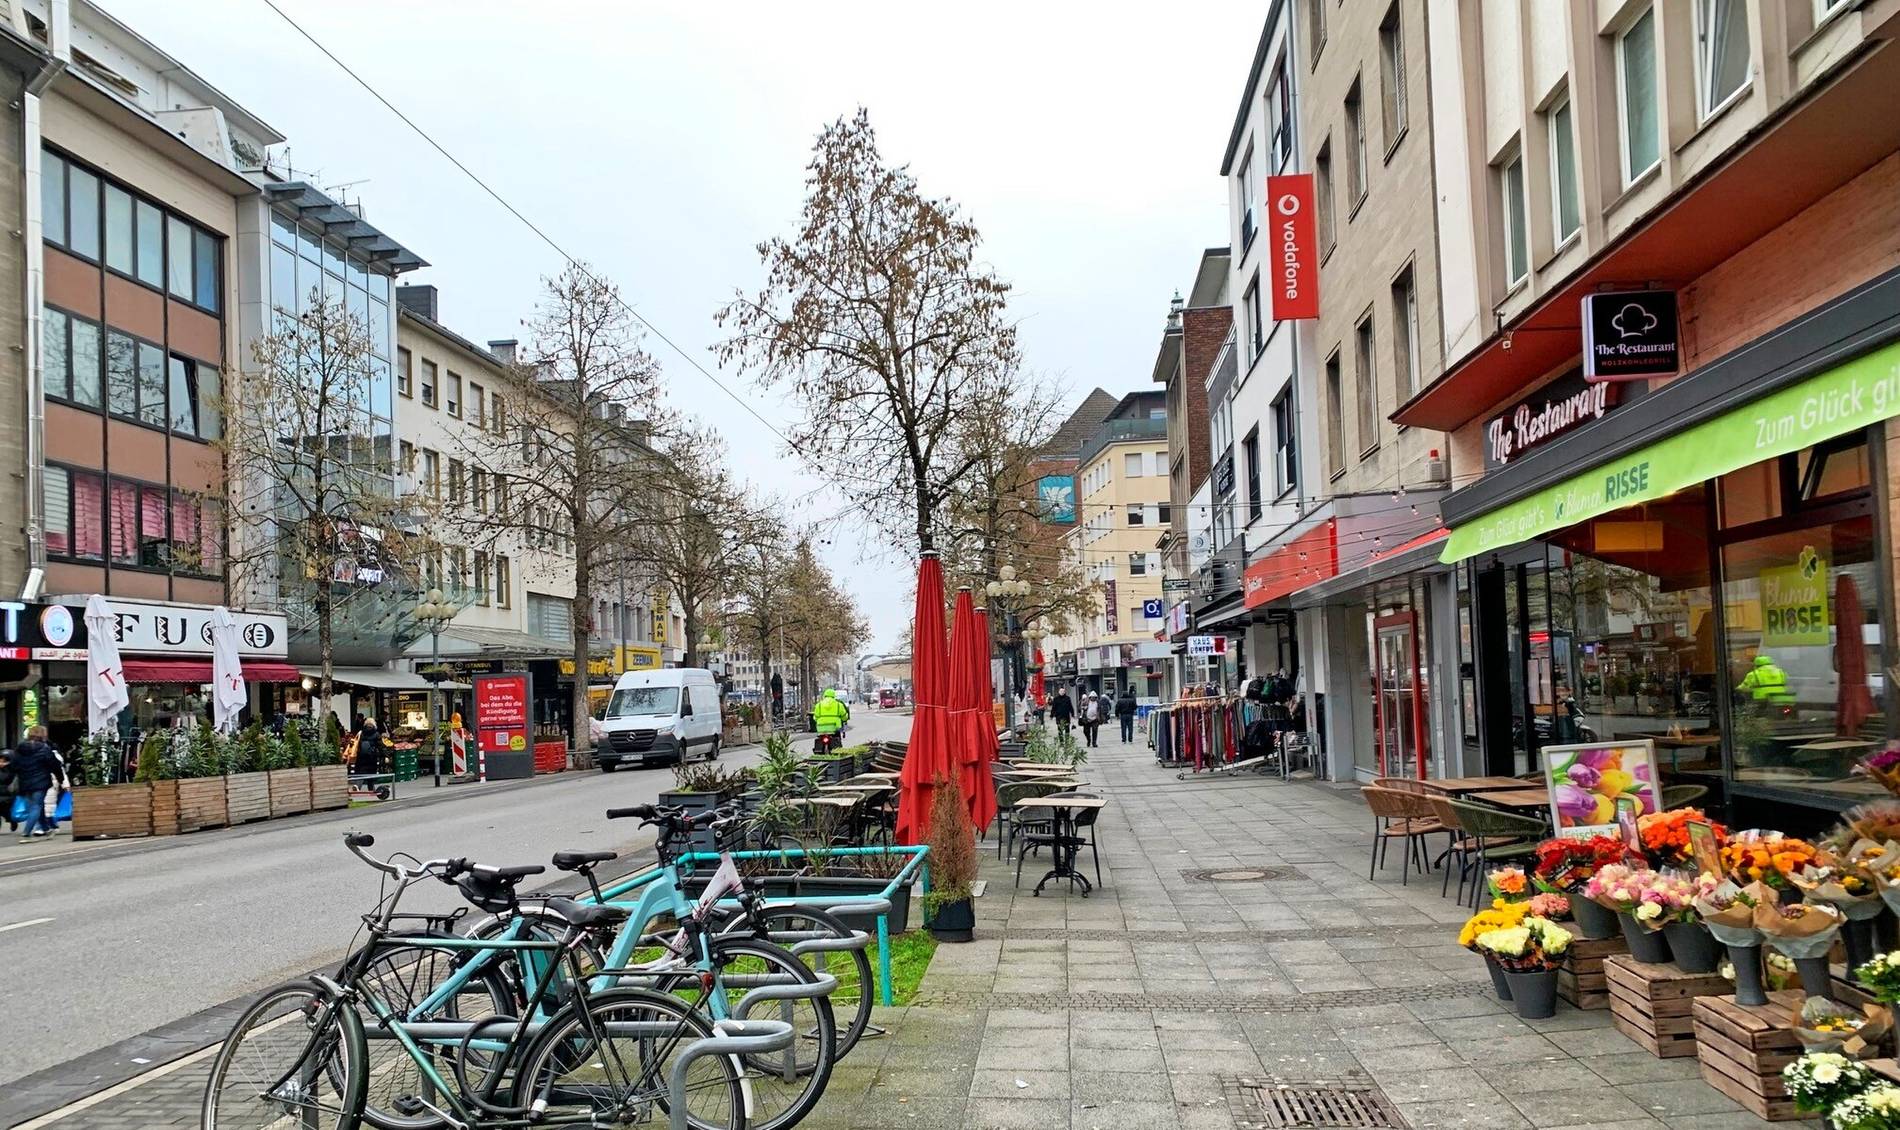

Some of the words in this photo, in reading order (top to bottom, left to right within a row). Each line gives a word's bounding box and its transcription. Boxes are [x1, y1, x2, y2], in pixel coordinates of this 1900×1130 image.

[1283, 220, 1300, 299] vodafone
[1595, 344, 1616, 356] The
[1616, 342, 1675, 355] Restaurant
[1489, 417, 1512, 464] The
[1514, 381, 1609, 449] Restaurant
[1755, 415, 1794, 448] Zum
[1800, 379, 1863, 430] Glück
[1872, 362, 1900, 416] gi
[1519, 504, 1545, 536] gibt's
[1605, 462, 1649, 503] RISSE
[1767, 606, 1823, 635] RISSE
[633, 653, 654, 666] ZEEMAN
